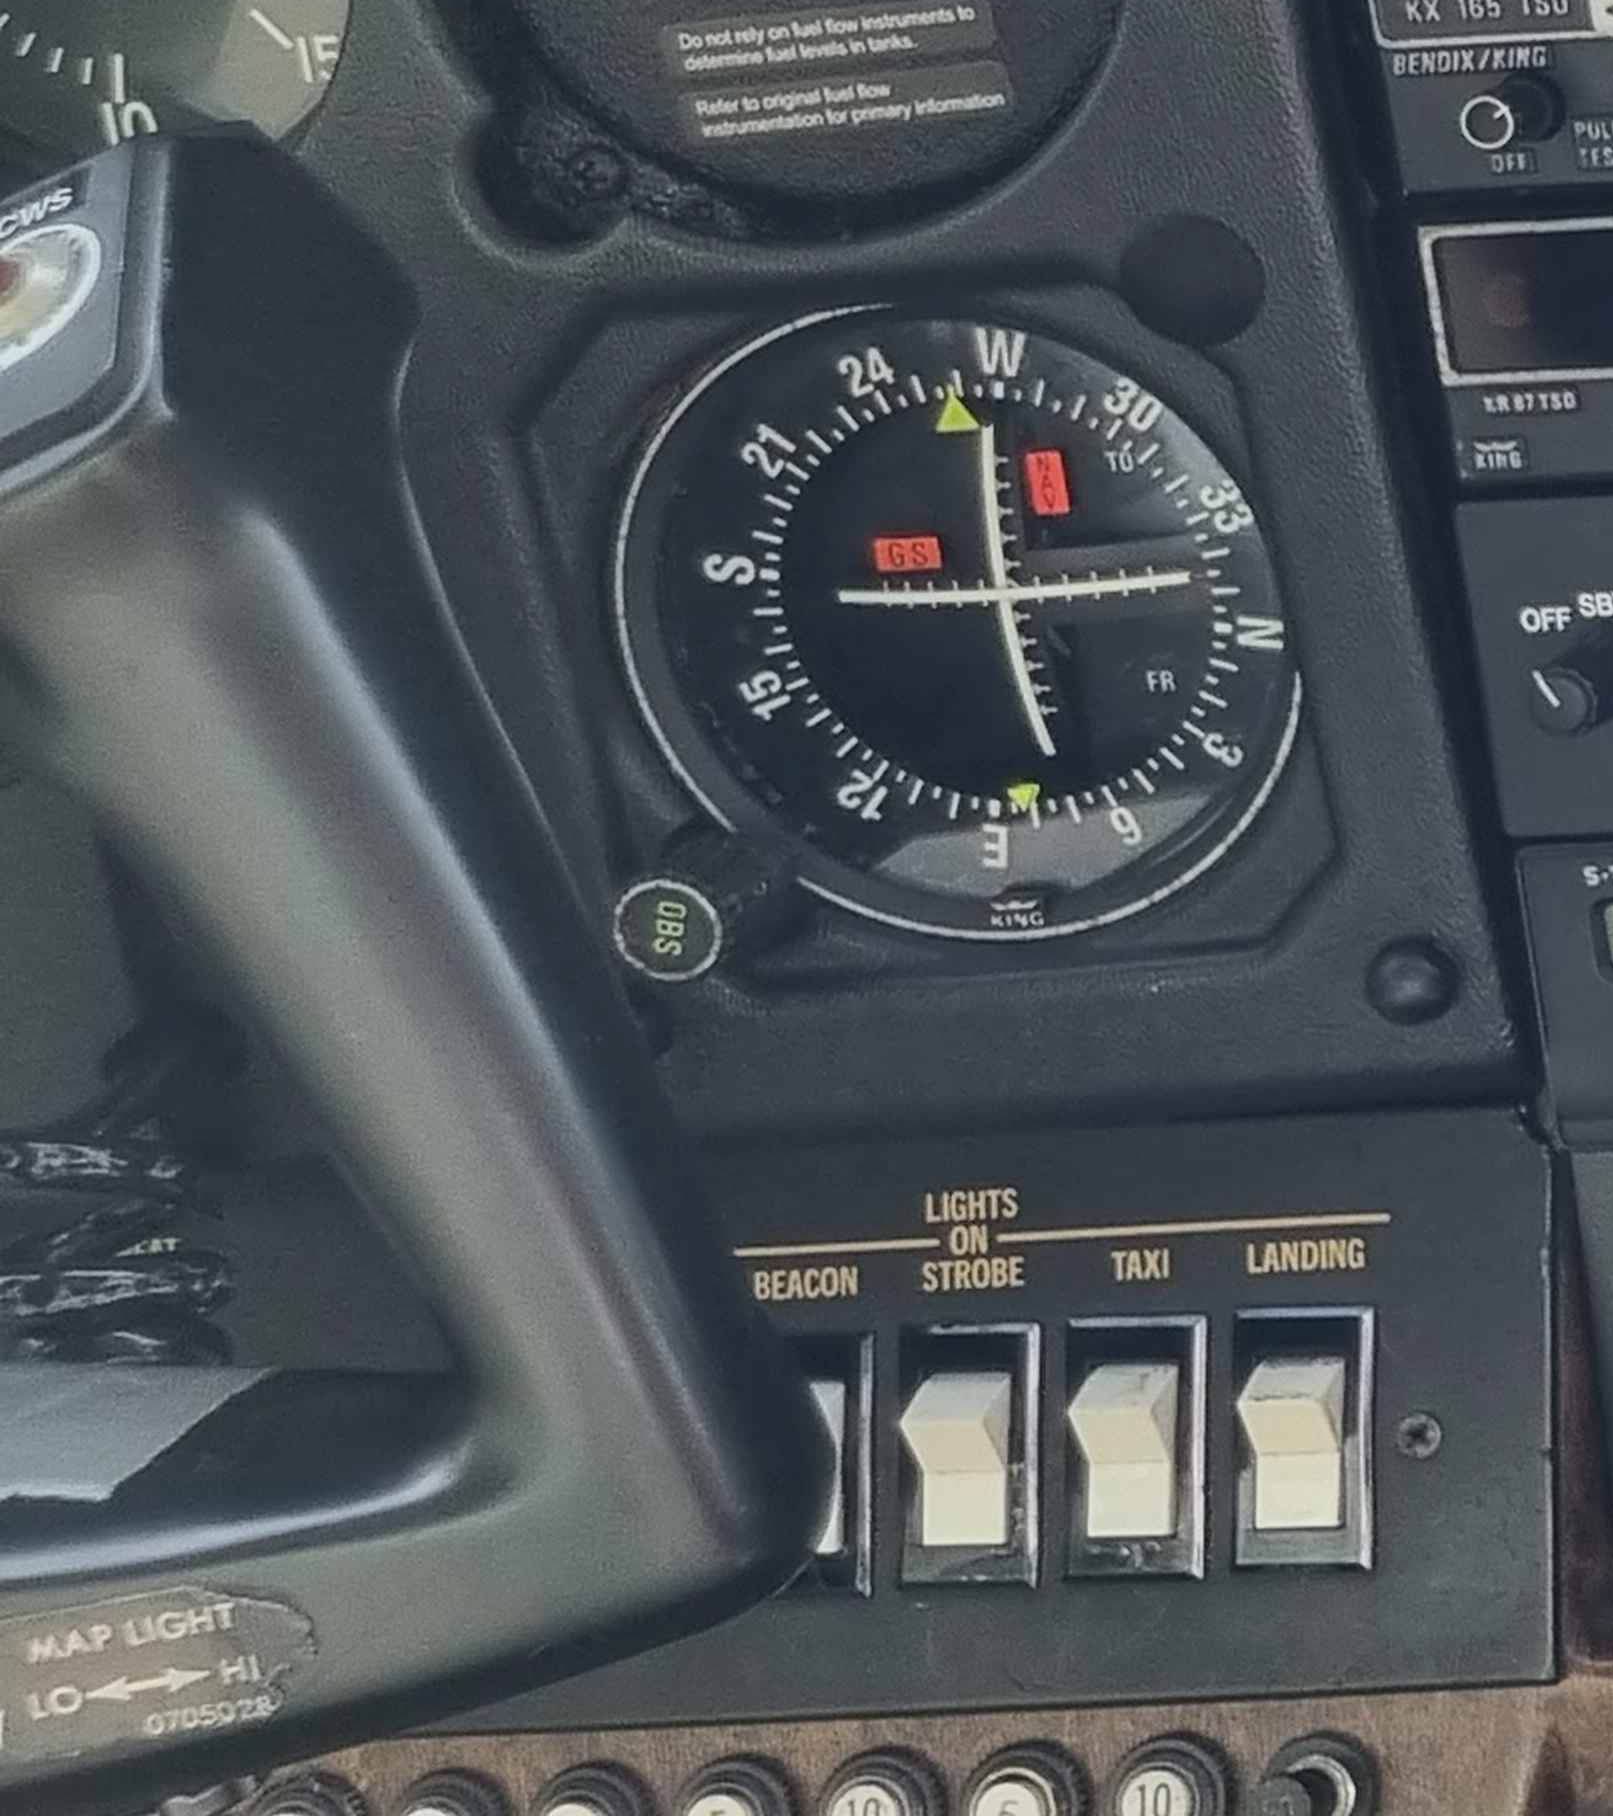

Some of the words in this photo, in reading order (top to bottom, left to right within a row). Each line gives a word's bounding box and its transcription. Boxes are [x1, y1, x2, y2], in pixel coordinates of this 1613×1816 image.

[678, 32, 702, 49] Do
[706, 29, 732, 46] not
[735, 26, 764, 44] rely
[768, 25, 789, 39] on
[792, 21, 823, 37] fuel
[825, 17, 858, 34] flow
[861, 9, 955, 30] instruments
[958, 6, 974, 21] to
[1392, 46, 1547, 75] BENDIX/KING
[838, 347, 894, 394] 24
[887, 541, 929, 564] GS
[1521, 607, 1570, 632] OFF
[654, 901, 687, 957] OBS
[925, 1189, 1019, 1223] LIGHTS
[950, 1226, 989, 1255] ON
[1247, 1240, 1366, 1275] LANDING
[754, 1266, 858, 1300] BEACON
[922, 1257, 1025, 1292] STROBE
[1111, 1250, 1170, 1282] TAXI
[27, 1624, 111, 1663] MAP
[124, 1602, 236, 1644] LIGHT
[30, 1686, 82, 1720] LO
[221, 1655, 259, 1683] HI
